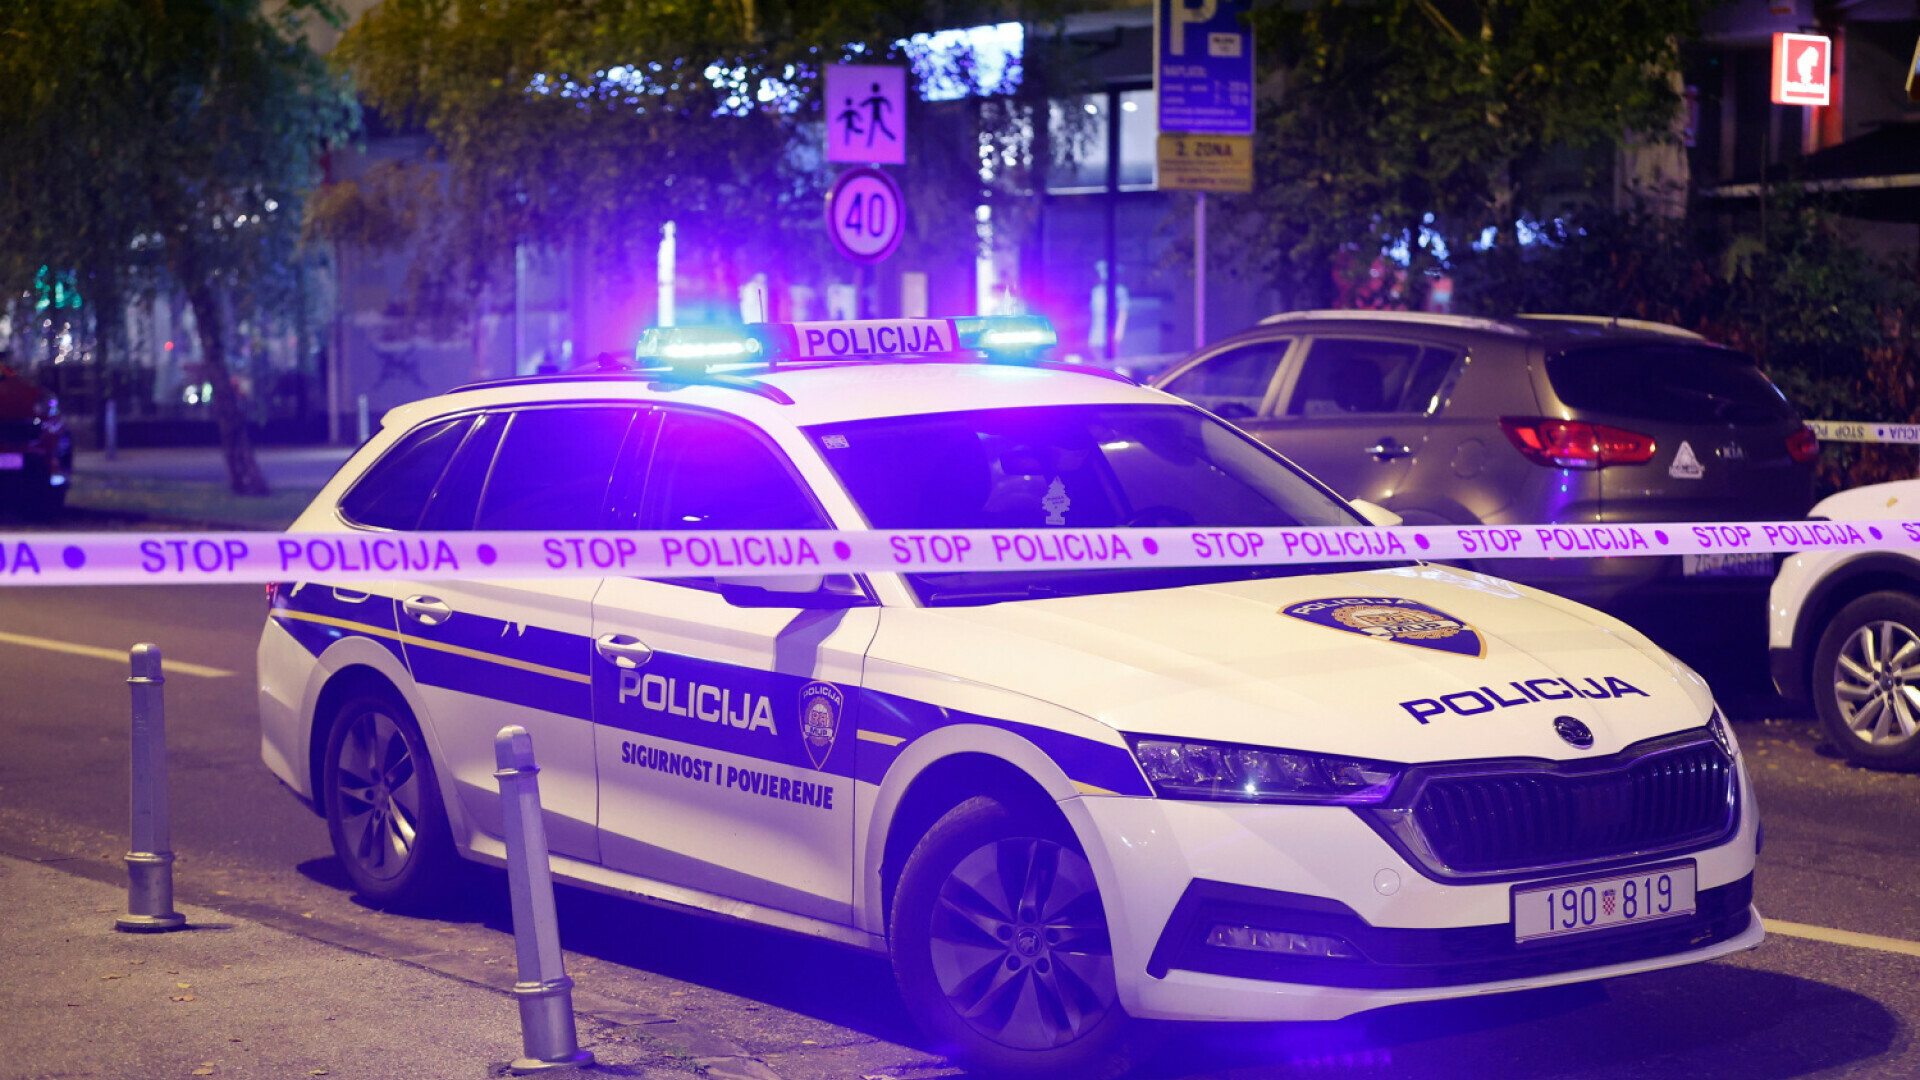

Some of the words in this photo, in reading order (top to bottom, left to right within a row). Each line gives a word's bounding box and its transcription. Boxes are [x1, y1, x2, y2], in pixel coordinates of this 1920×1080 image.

[1170, 0, 1217, 56] P
[845, 192, 886, 238] 40
[806, 325, 944, 356] POLICIJA
[140, 539, 249, 573] STOP
[278, 539, 460, 572] POLICIJA
[543, 537, 637, 569] STOP
[661, 536, 819, 567] POLICIJA
[890, 535, 971, 563] STOP
[992, 534, 1132, 562] POLICIJA
[1192, 532, 1264, 558] STOP
[1280, 531, 1406, 556] POLICIJA
[1457, 529, 1522, 552] STOP
[1536, 528, 1649, 551] POLICIJA
[1692, 526, 1751, 548] STOP
[1762, 524, 1866, 546] POLICIJA
[1292, 597, 1418, 616] POLICIJA
[618, 668, 778, 736] POLICIJA
[803, 685, 840, 706] POLICIJA
[1399, 676, 1651, 725] POLICIJA
[622, 741, 712, 783] SIGURNOST
[716, 763, 723, 786] I
[727, 766, 834, 810] POVJERENJE
[1547, 886, 1596, 931] 190
[1622, 873, 1673, 919] 819
